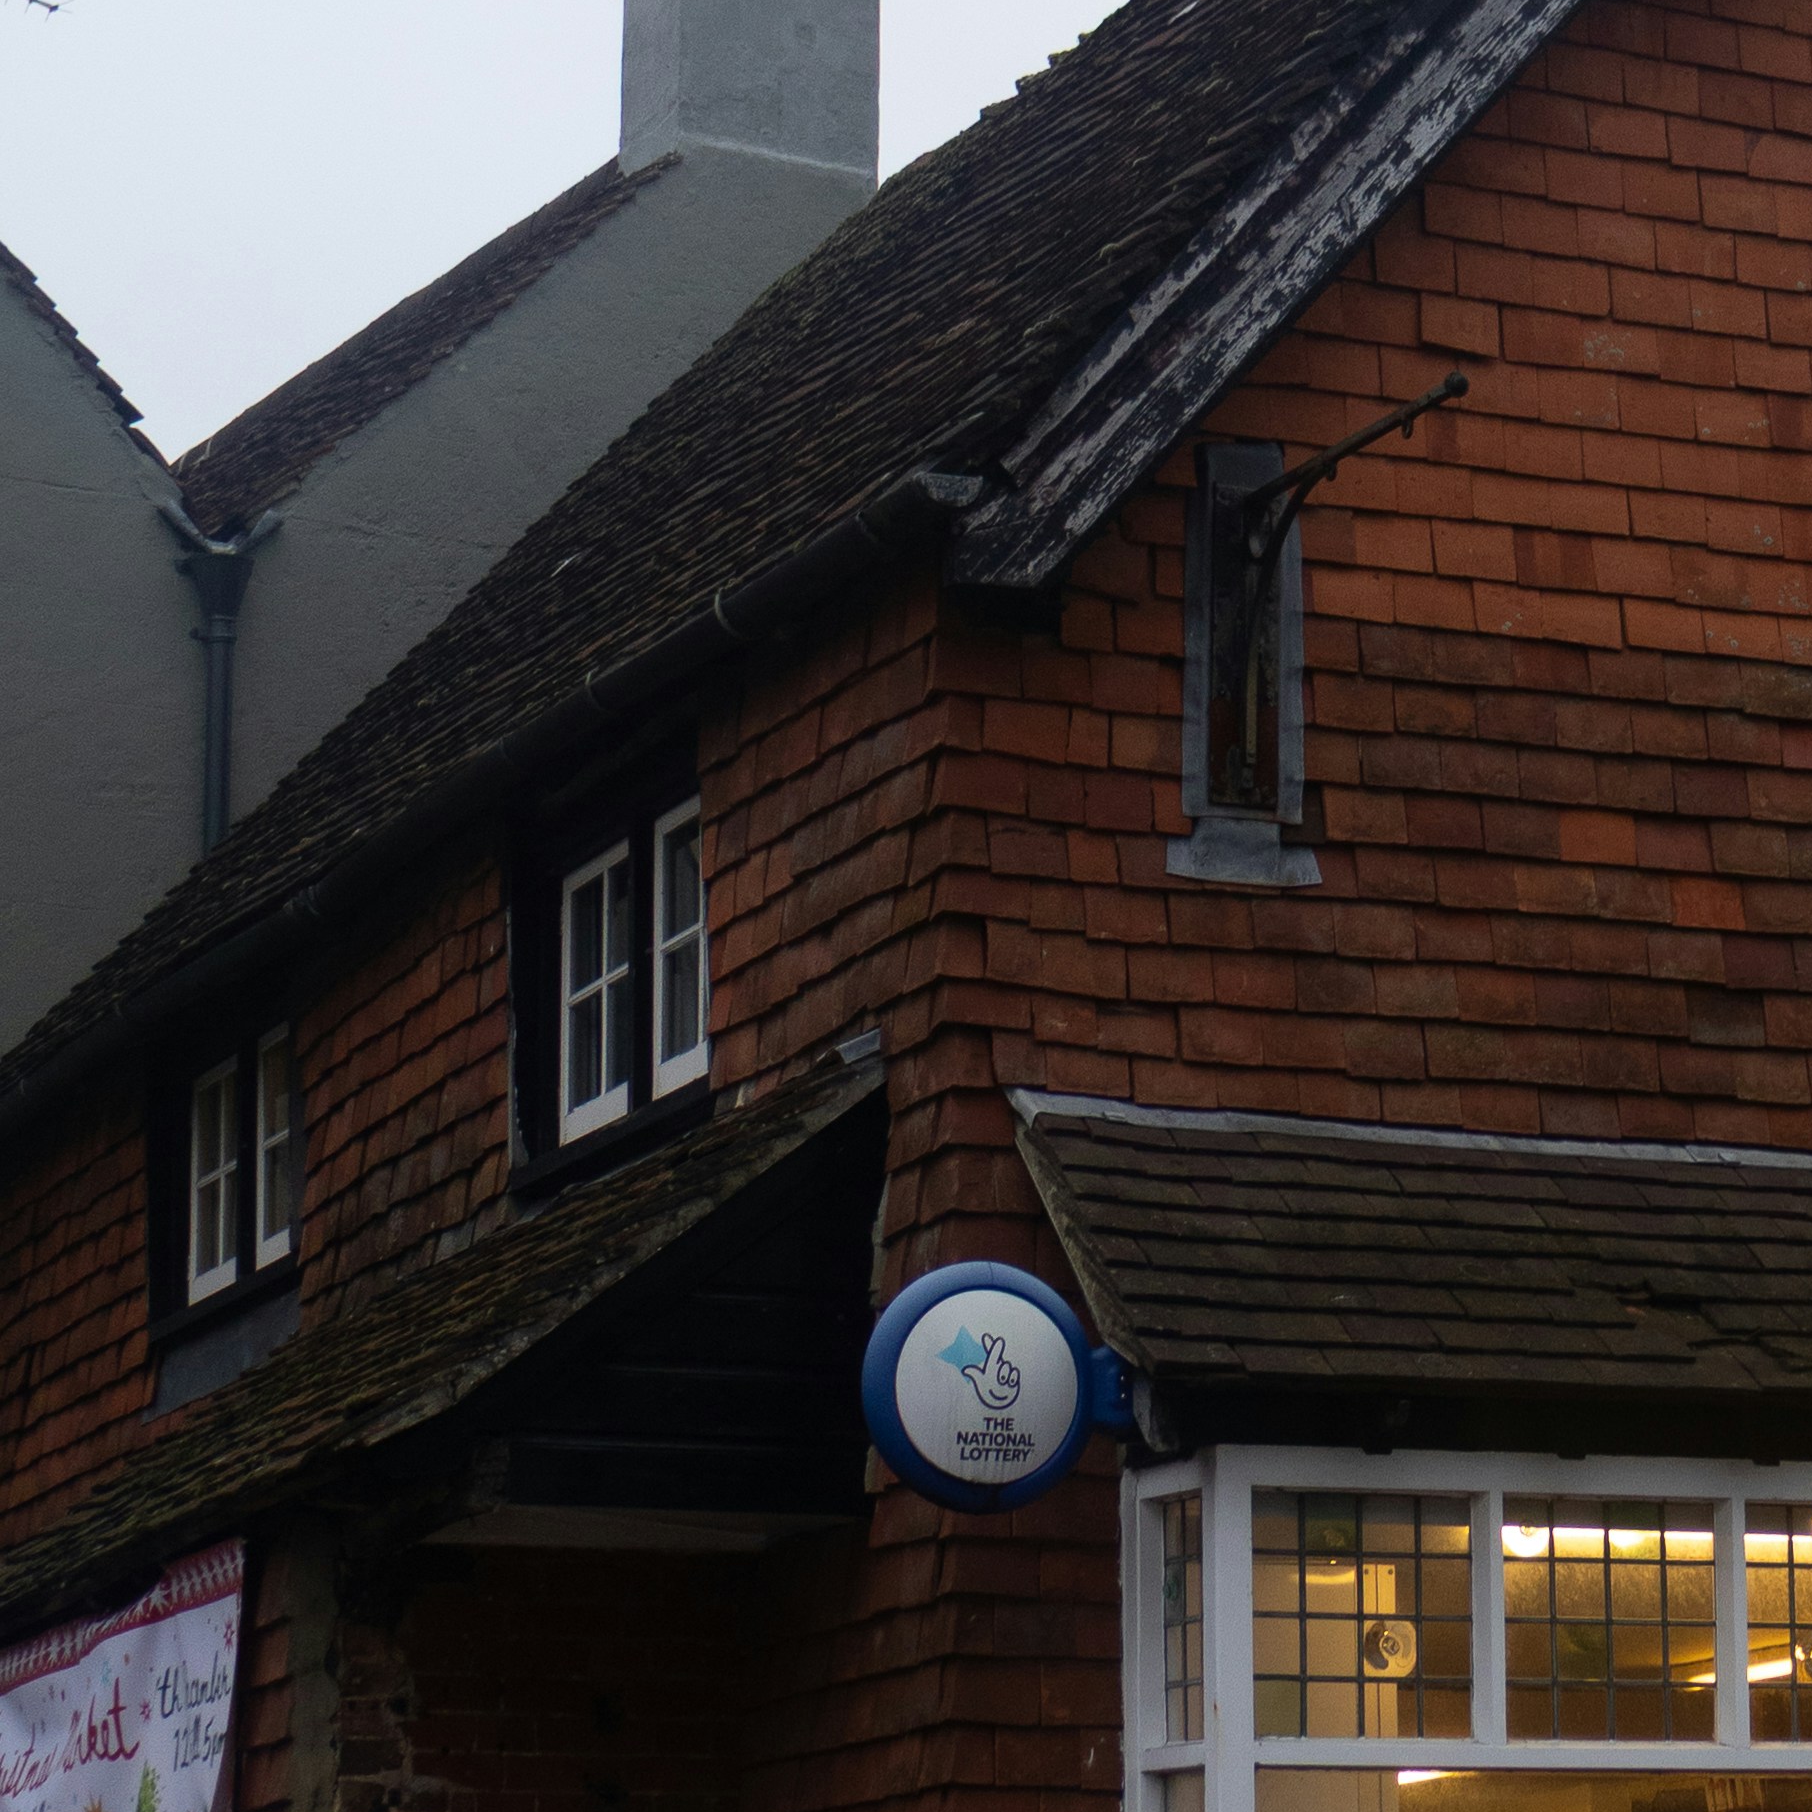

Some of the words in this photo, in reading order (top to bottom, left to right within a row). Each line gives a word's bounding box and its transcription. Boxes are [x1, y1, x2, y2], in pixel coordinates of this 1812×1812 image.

[983, 1417, 1014, 1432] THE
[956, 1432, 1035, 1448] NATIONAL
[960, 1448, 1031, 1463] LOTTERY
